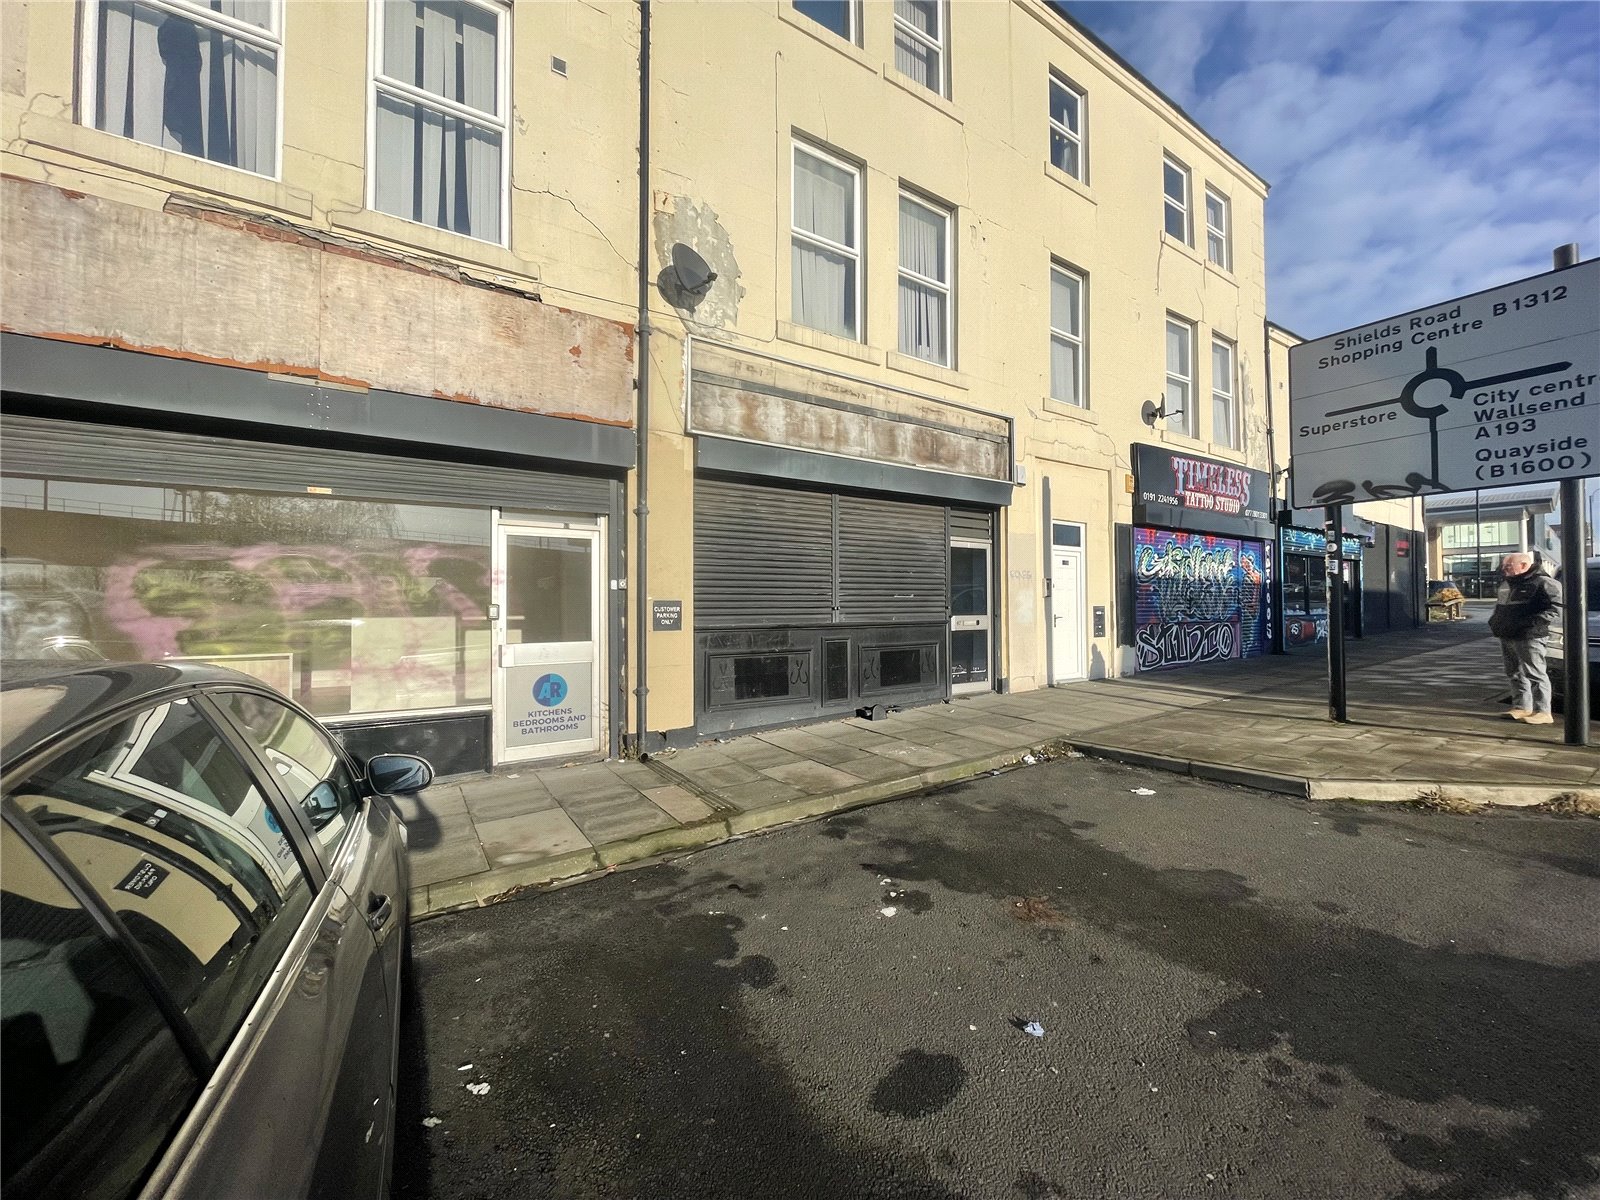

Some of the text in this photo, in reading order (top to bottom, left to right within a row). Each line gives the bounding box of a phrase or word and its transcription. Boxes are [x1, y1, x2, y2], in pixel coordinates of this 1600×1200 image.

[1492, 285, 1568, 318] B1312
[1334, 306, 1462, 351] Shields Road
[1318, 319, 1483, 370] Shopping Centre
[1473, 373, 1600, 407] City centr
[1474, 392, 1585, 423] Wallsend
[1299, 410, 1398, 438] Superstore
[1475, 436, 1588, 462] Quayside
[1475, 451, 1592, 481] (B1600)
[1171, 456, 1252, 508] TIMELESS
[1185, 491, 1241, 514] TATTOO STUDIO
[513, 714, 586, 728] BEDROOMS AND
[527, 707, 573, 718] KITCHENS
[521, 723, 579, 735] BATHROOMS
